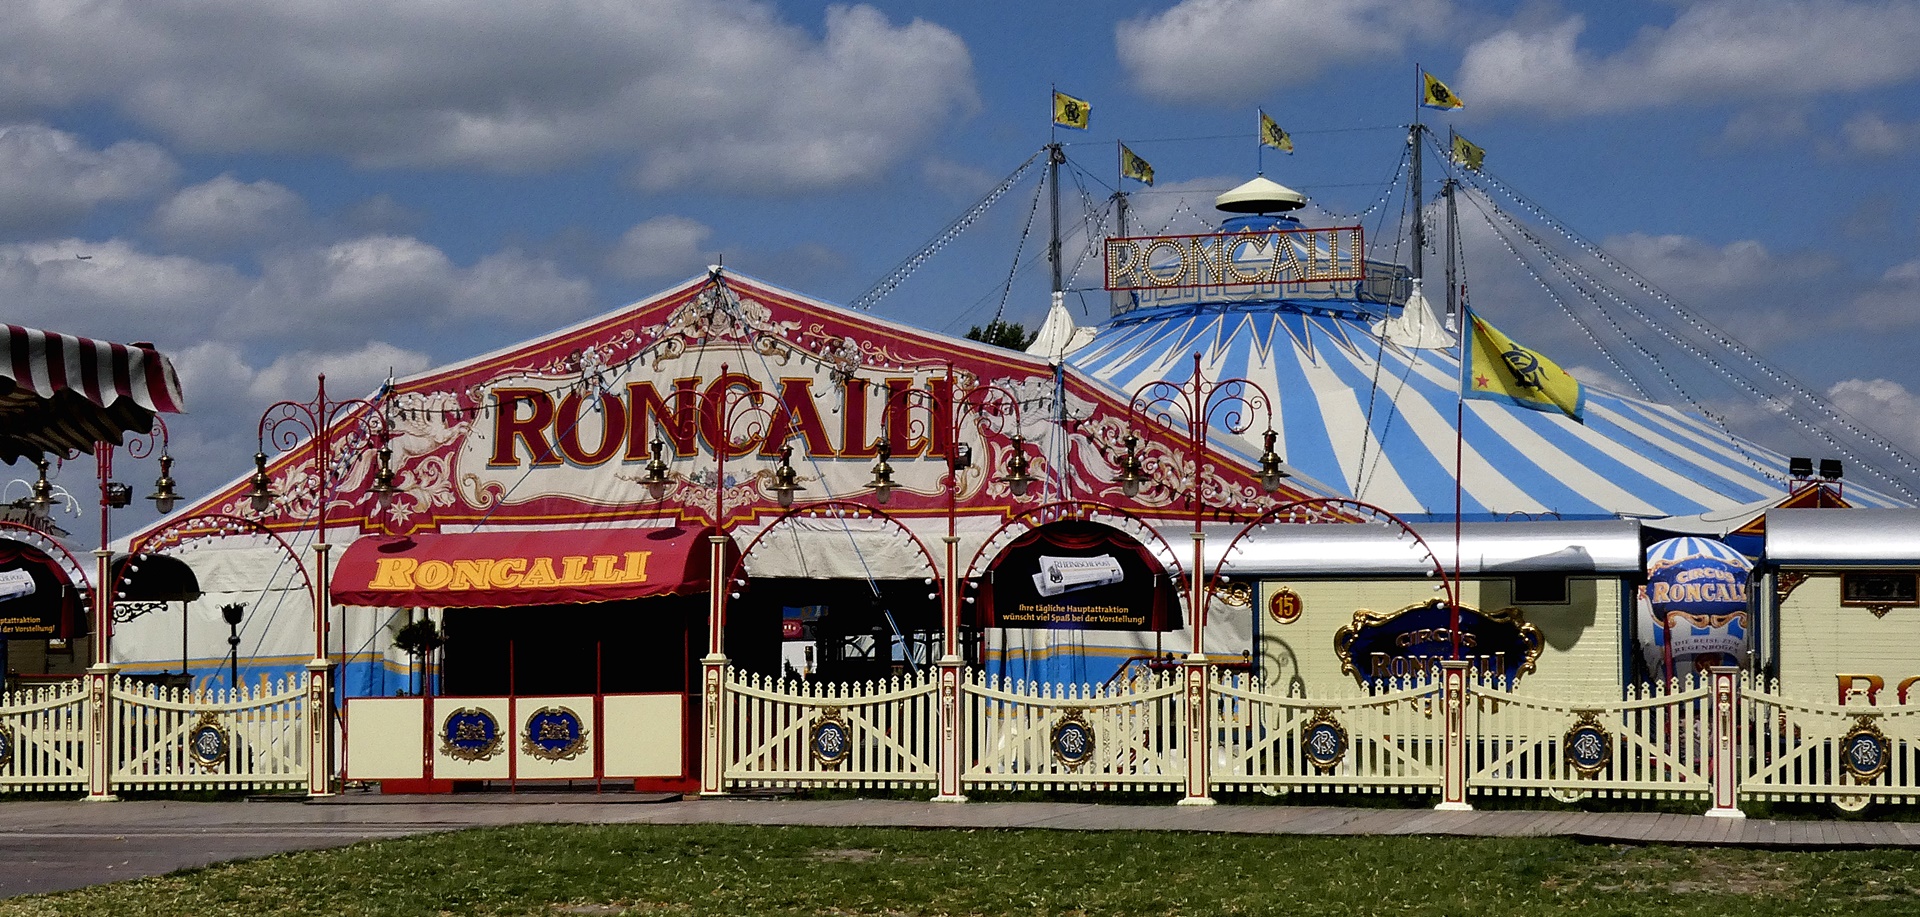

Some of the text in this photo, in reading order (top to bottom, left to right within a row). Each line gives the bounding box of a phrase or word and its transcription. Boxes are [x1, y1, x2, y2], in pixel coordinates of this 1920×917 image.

[1108, 228, 1361, 289] RONCALLI
[488, 373, 958, 467] RONCALLI
[368, 551, 652, 590] RONCALLI
[1675, 567, 1735, 583] CIRCUS
[1018, 604, 1129, 614] Ihre tägliche Hauptattraktion
[1275, 596, 1294, 617] 15
[15, 625, 55, 633] Vorstellung!
[1002, 613, 1035, 621] wünscht
[1051, 614, 1070, 623] Spaß
[1072, 614, 1084, 622] bei
[1099, 615, 1145, 625] Vorstellung!
[1395, 627, 1478, 648] CIRCUS
[1370, 652, 1506, 678] RONCLLI
